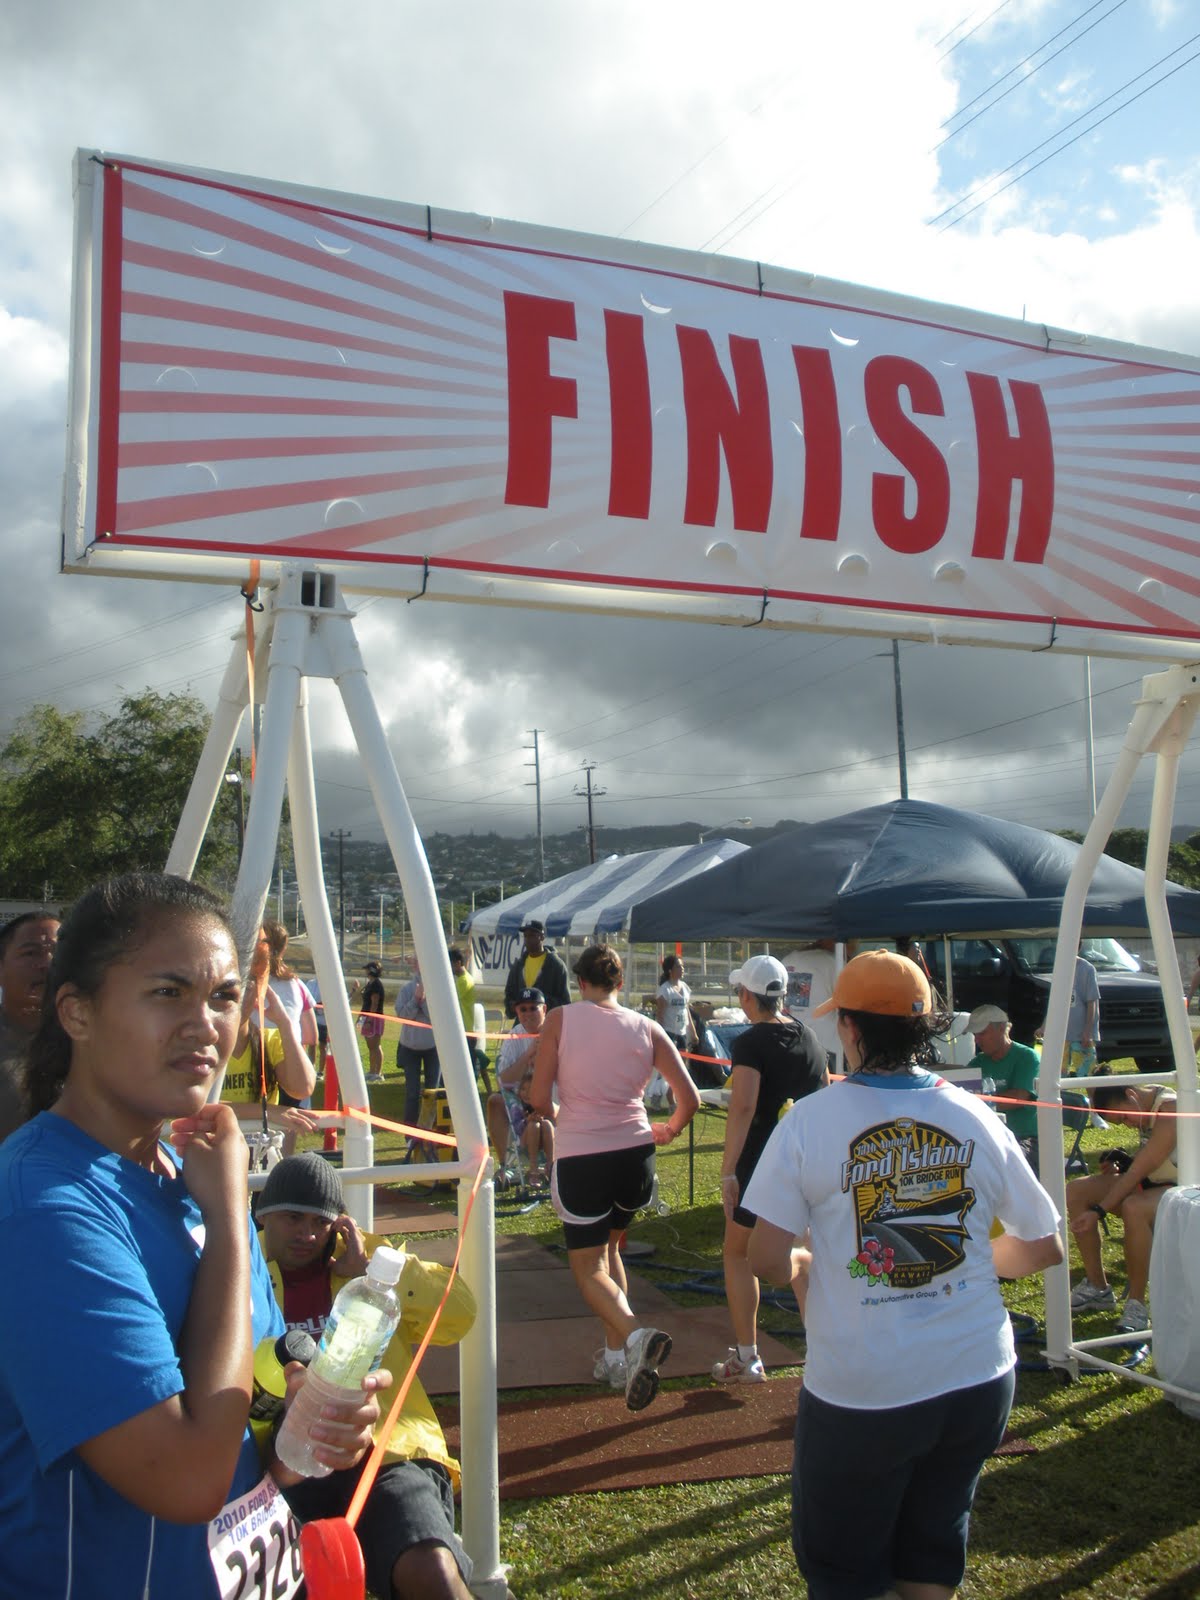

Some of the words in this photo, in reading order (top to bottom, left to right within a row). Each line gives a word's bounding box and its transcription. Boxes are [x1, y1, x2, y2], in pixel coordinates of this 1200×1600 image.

[503, 290, 1055, 564] FINISH
[471, 934, 526, 970] MEDIC
[221, 1072, 253, 1090] NER'S
[842, 1149, 895, 1193] Ford
[901, 1139, 974, 1174] Island
[900, 1175, 914, 1188] 10K
[916, 1169, 944, 1184] BRIDGE
[945, 1166, 960, 1180] RUN
[893, 1271, 930, 1279] HAWAII
[880, 1293, 915, 1304] Automotive
[916, 1290, 938, 1299] Group
[214, 1504, 247, 1535] 2010
[248, 1489, 268, 1514] FORD
[228, 1523, 249, 1545] 10K
